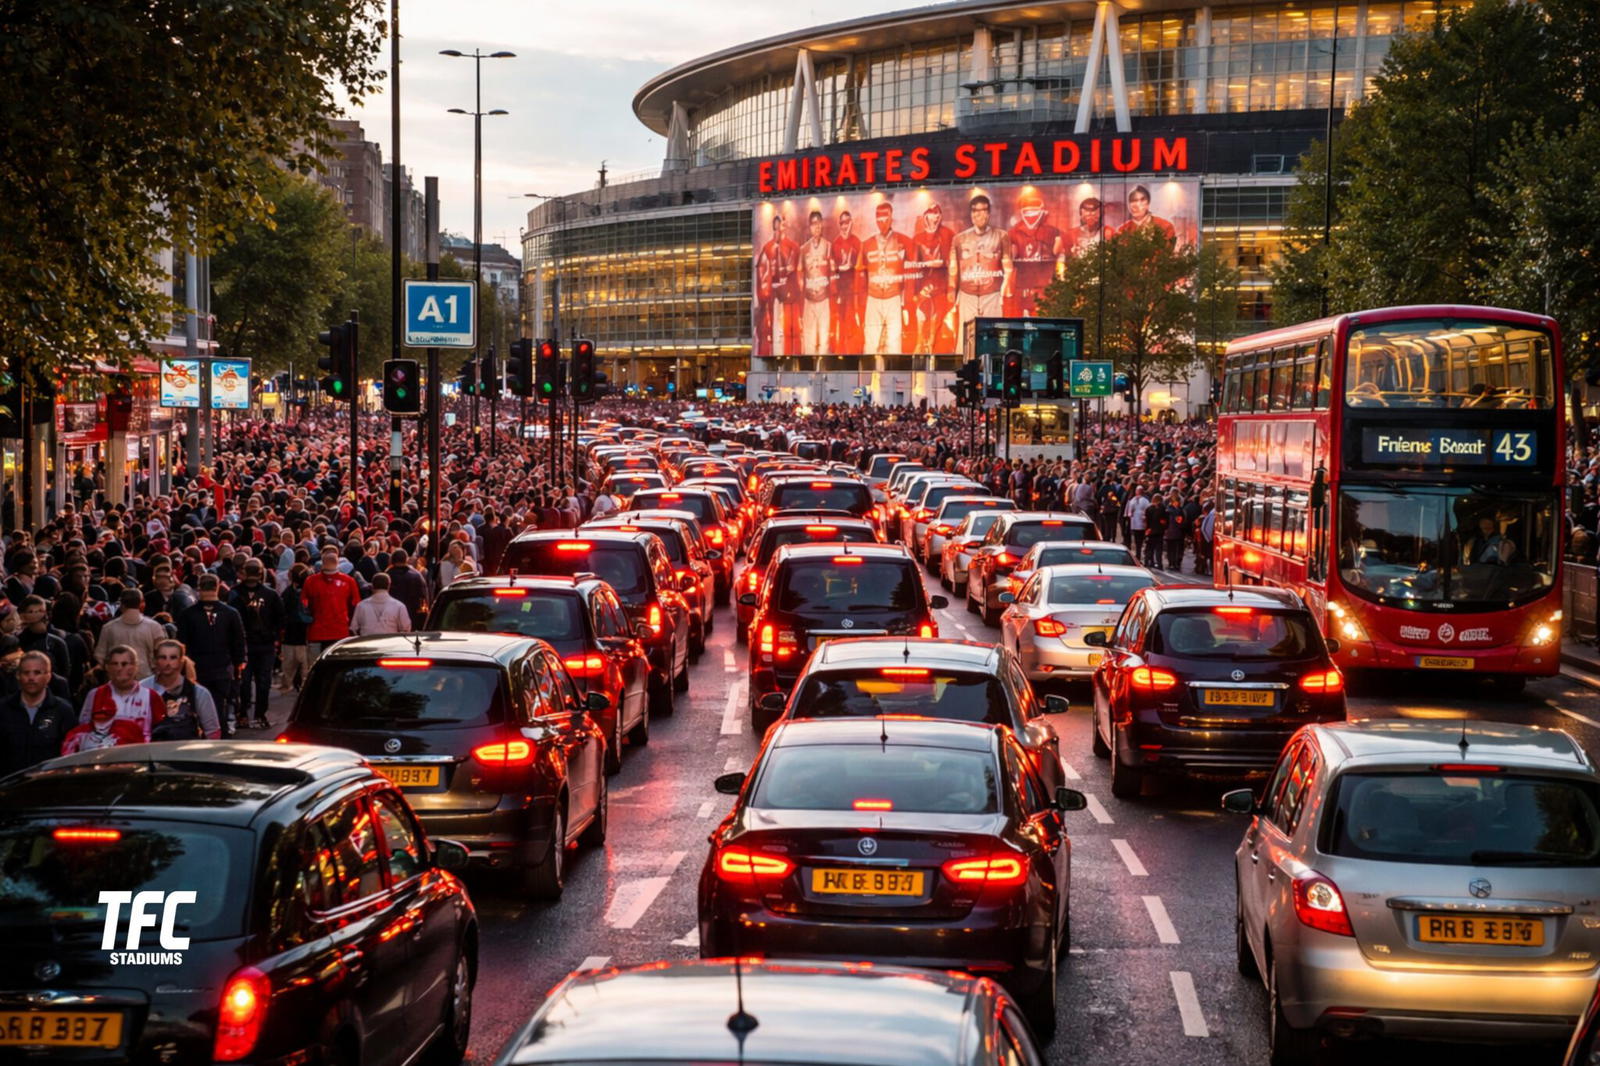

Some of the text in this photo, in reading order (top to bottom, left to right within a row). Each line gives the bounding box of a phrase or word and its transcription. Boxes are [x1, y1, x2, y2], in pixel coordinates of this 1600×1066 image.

[758, 137, 1189, 193] EMIRATES STADIUM
[417, 295, 458, 324] A1
[1495, 432, 1532, 461] 43
